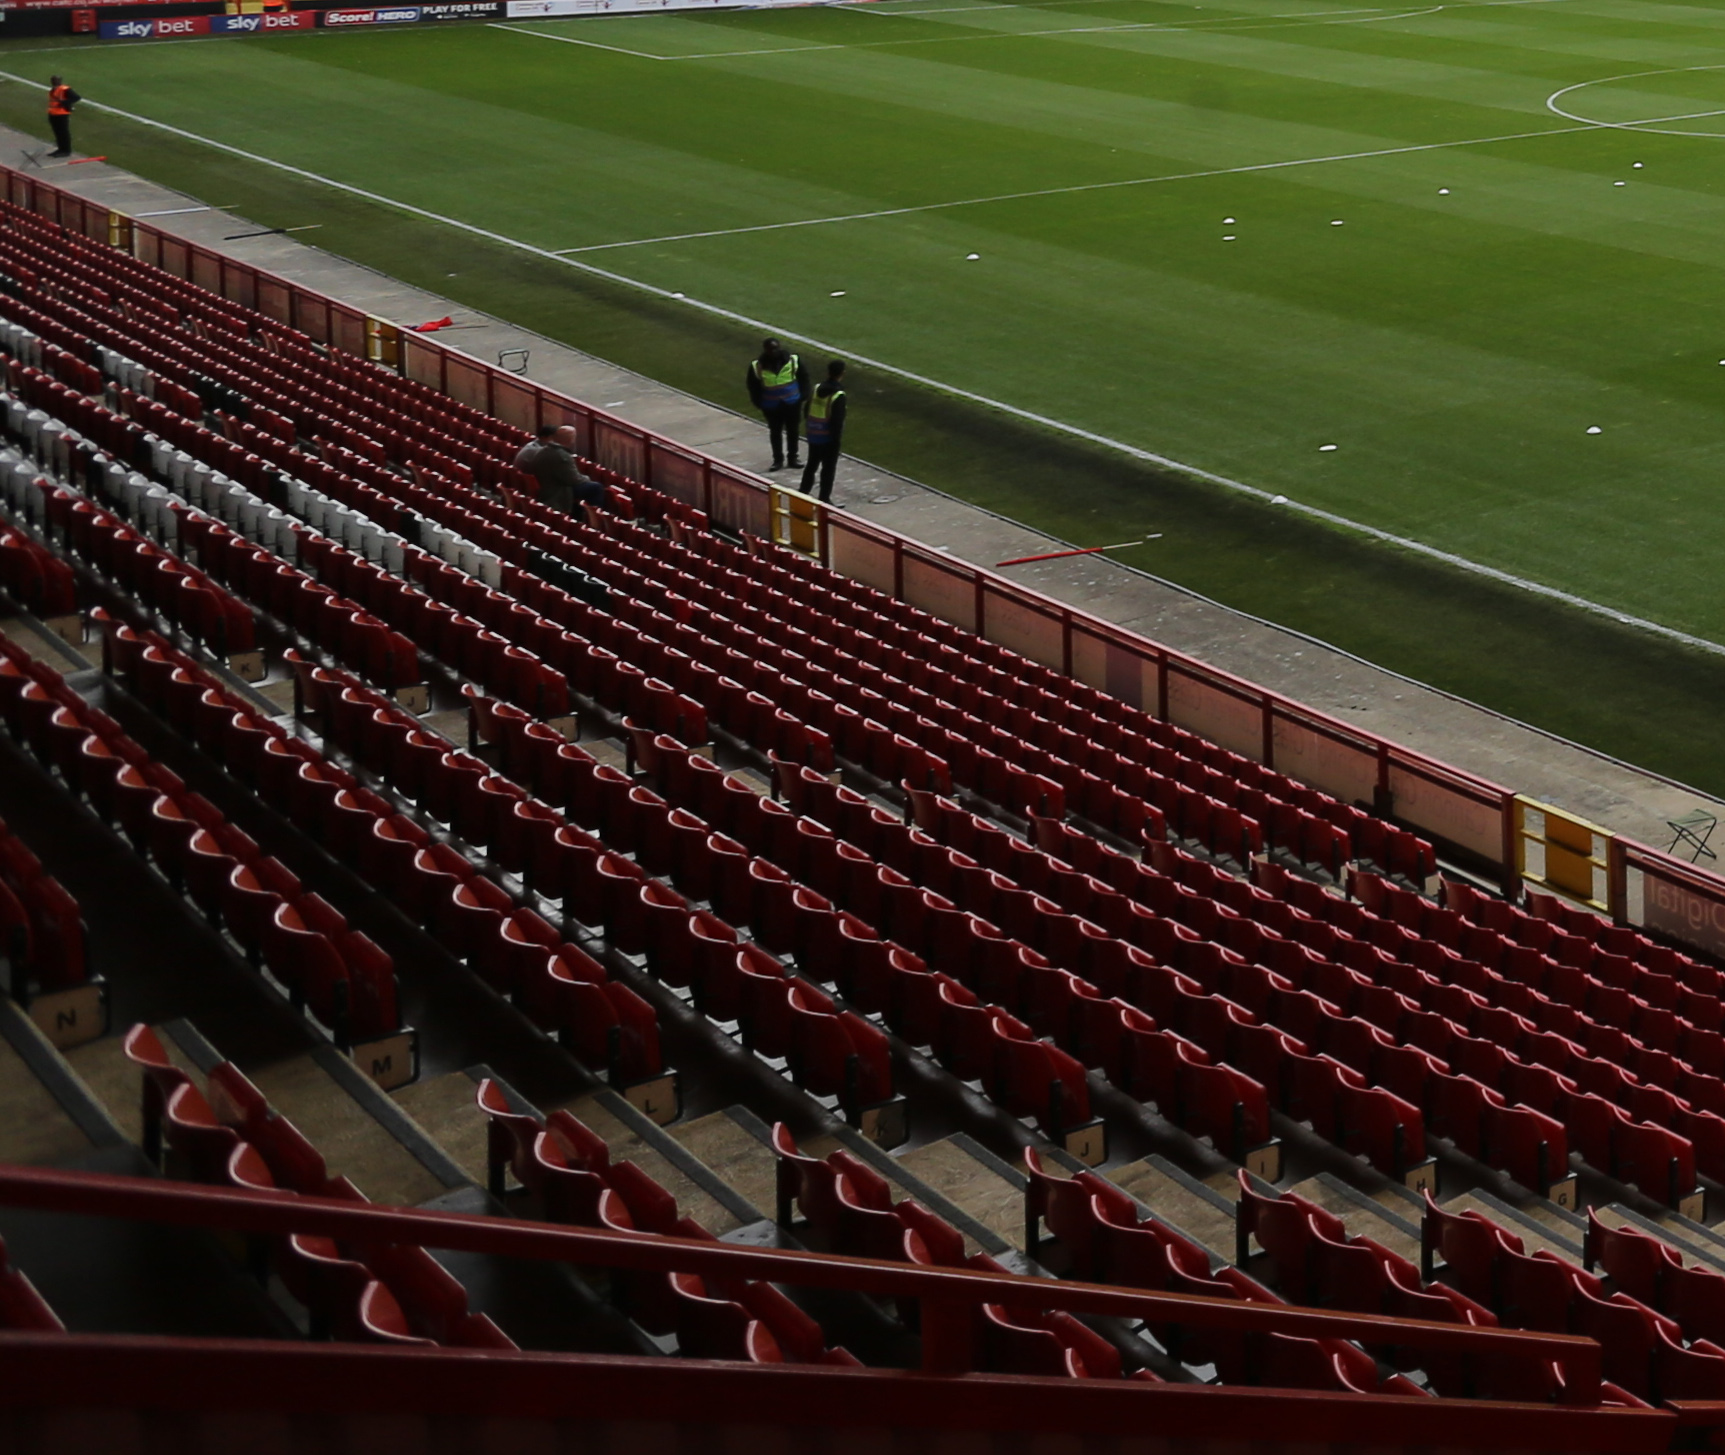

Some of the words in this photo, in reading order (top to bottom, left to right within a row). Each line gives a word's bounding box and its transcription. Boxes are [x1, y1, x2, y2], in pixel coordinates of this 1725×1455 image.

[328, 11, 375, 23] Score!
[376, 9, 417, 21] HERO
[423, 6, 449, 14] PLAY
[451, 5, 471, 13] FOR
[473, 2, 498, 12] FREE
[118, 22, 152, 37] sky
[158, 20, 194, 33] bet
[227, 15, 260, 31] sky
[265, 13, 299, 28] bet
[56, 1009, 77, 1031] N
[372, 1055, 392, 1077] M
[644, 1099, 658, 1116] L
[873, 1120, 889, 1137] K
[1080, 1141, 1090, 1158] J
[1415, 1177, 1426, 1192] H
[1557, 1192, 1568, 1207] G
